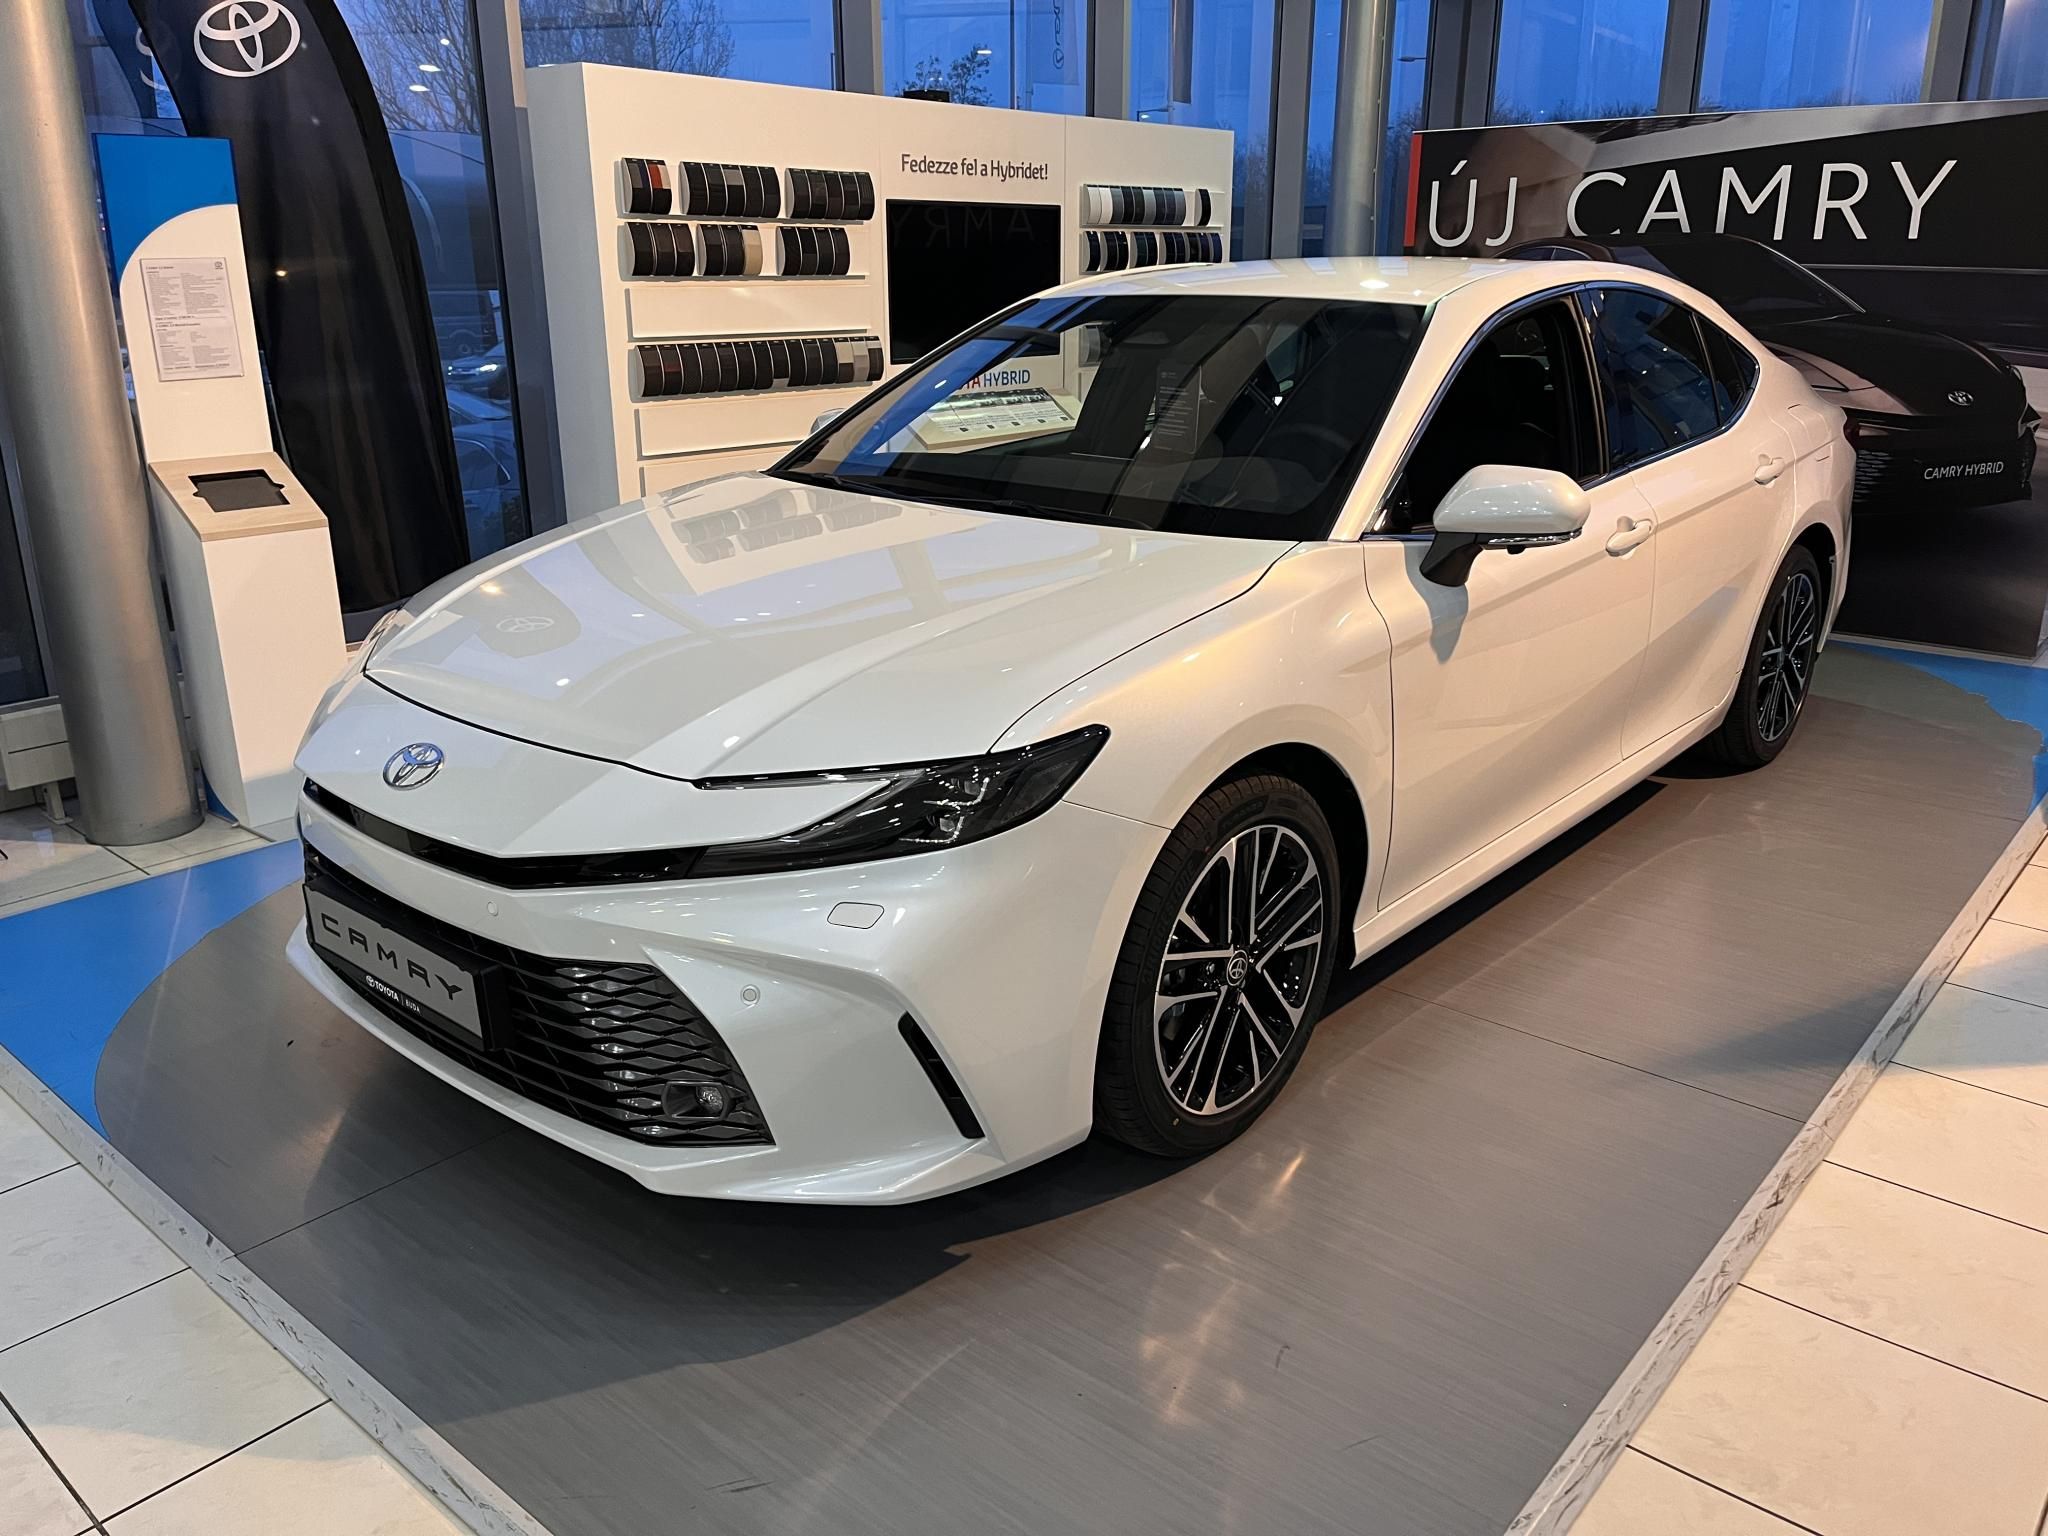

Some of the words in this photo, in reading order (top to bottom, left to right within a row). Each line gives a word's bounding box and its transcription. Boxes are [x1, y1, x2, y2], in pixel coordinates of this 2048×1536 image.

[901, 153, 958, 175] Fedezze
[961, 157, 978, 176] fel
[980, 163, 988, 177] a
[990, 159, 1048, 182] Hybridet!
[1427, 159, 1518, 248] ÚJ
[1566, 159, 1958, 241] CAMRY
[983, 369, 1031, 388] HYBRID
[1924, 465, 1964, 480] CAMRY
[1964, 461, 2004, 477] HYBRID
[320, 912, 464, 1001] CAMRY
[374, 980, 400, 1002] TOYOTA
[405, 998, 422, 1015] BUDA
